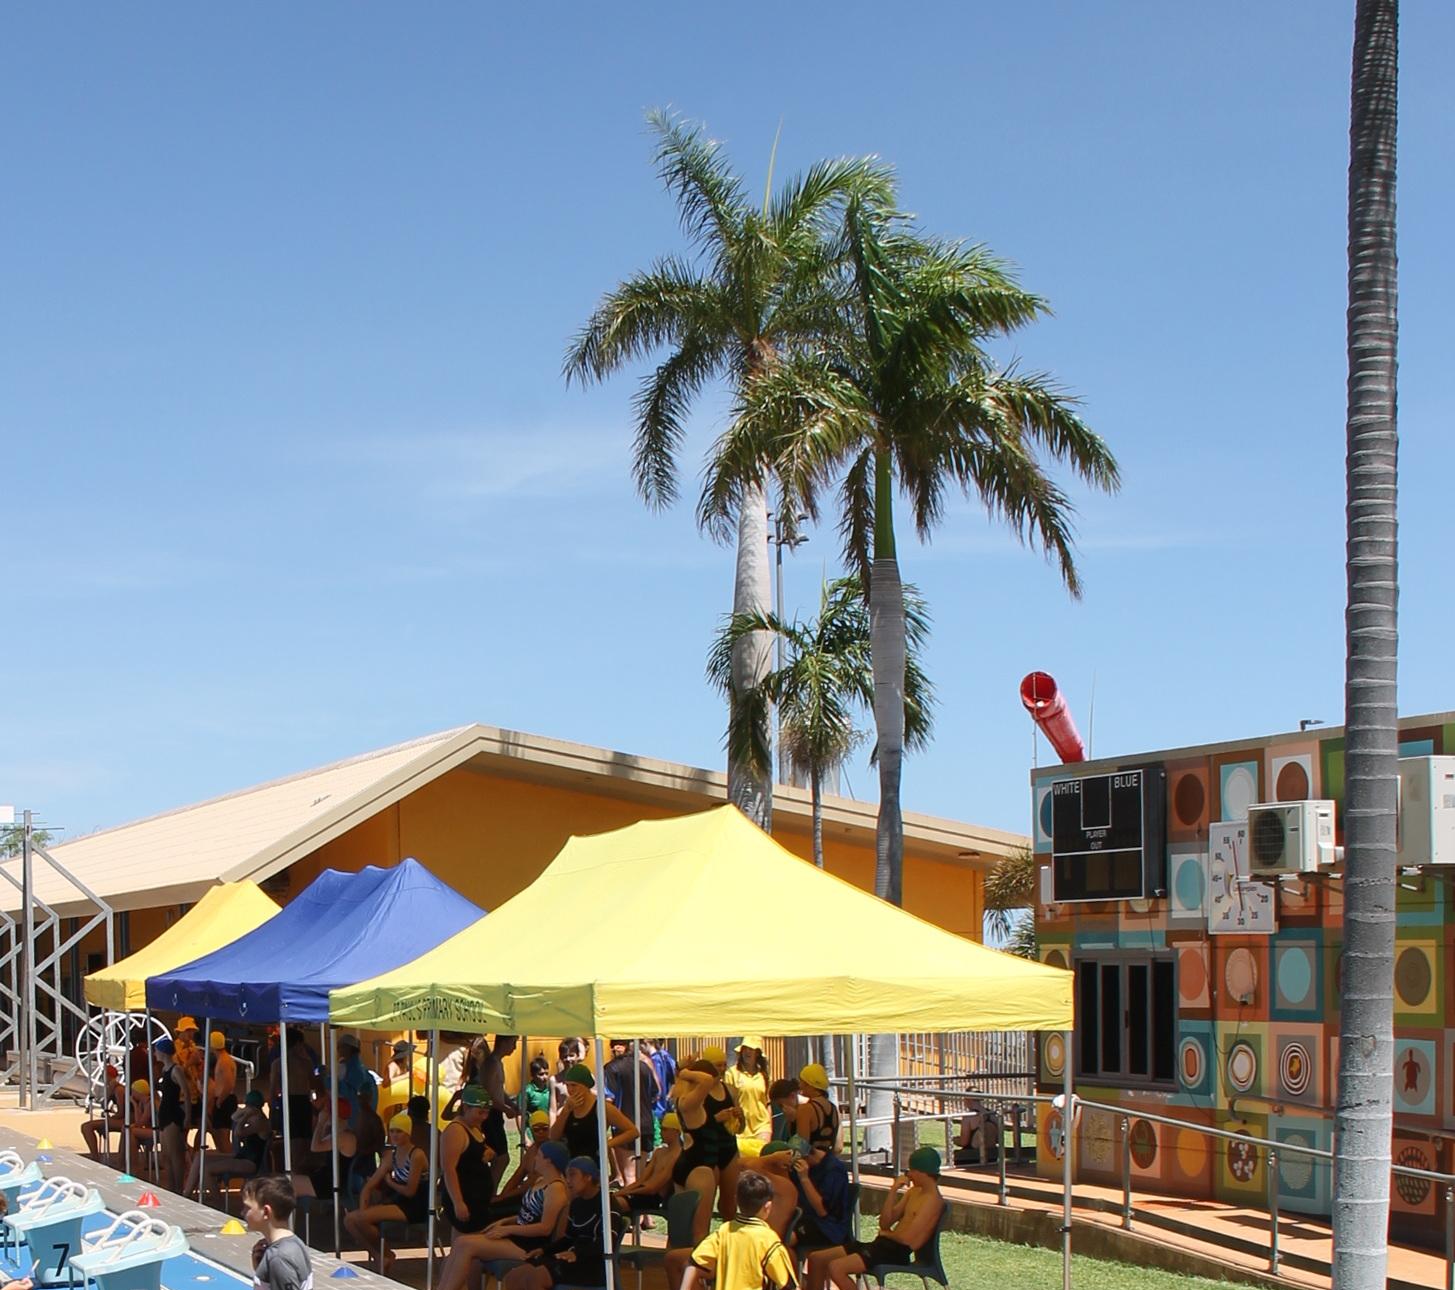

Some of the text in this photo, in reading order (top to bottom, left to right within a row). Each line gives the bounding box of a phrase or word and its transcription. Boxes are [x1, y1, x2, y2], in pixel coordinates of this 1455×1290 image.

[1053, 781, 1080, 796] WHITE
[1114, 774, 1138, 789] BLUE
[1086, 829, 1107, 839] PLAYER
[1090, 841, 1103, 850] OUT
[455, 998, 487, 1023] SCHOOL
[52, 1243, 70, 1277] 7
